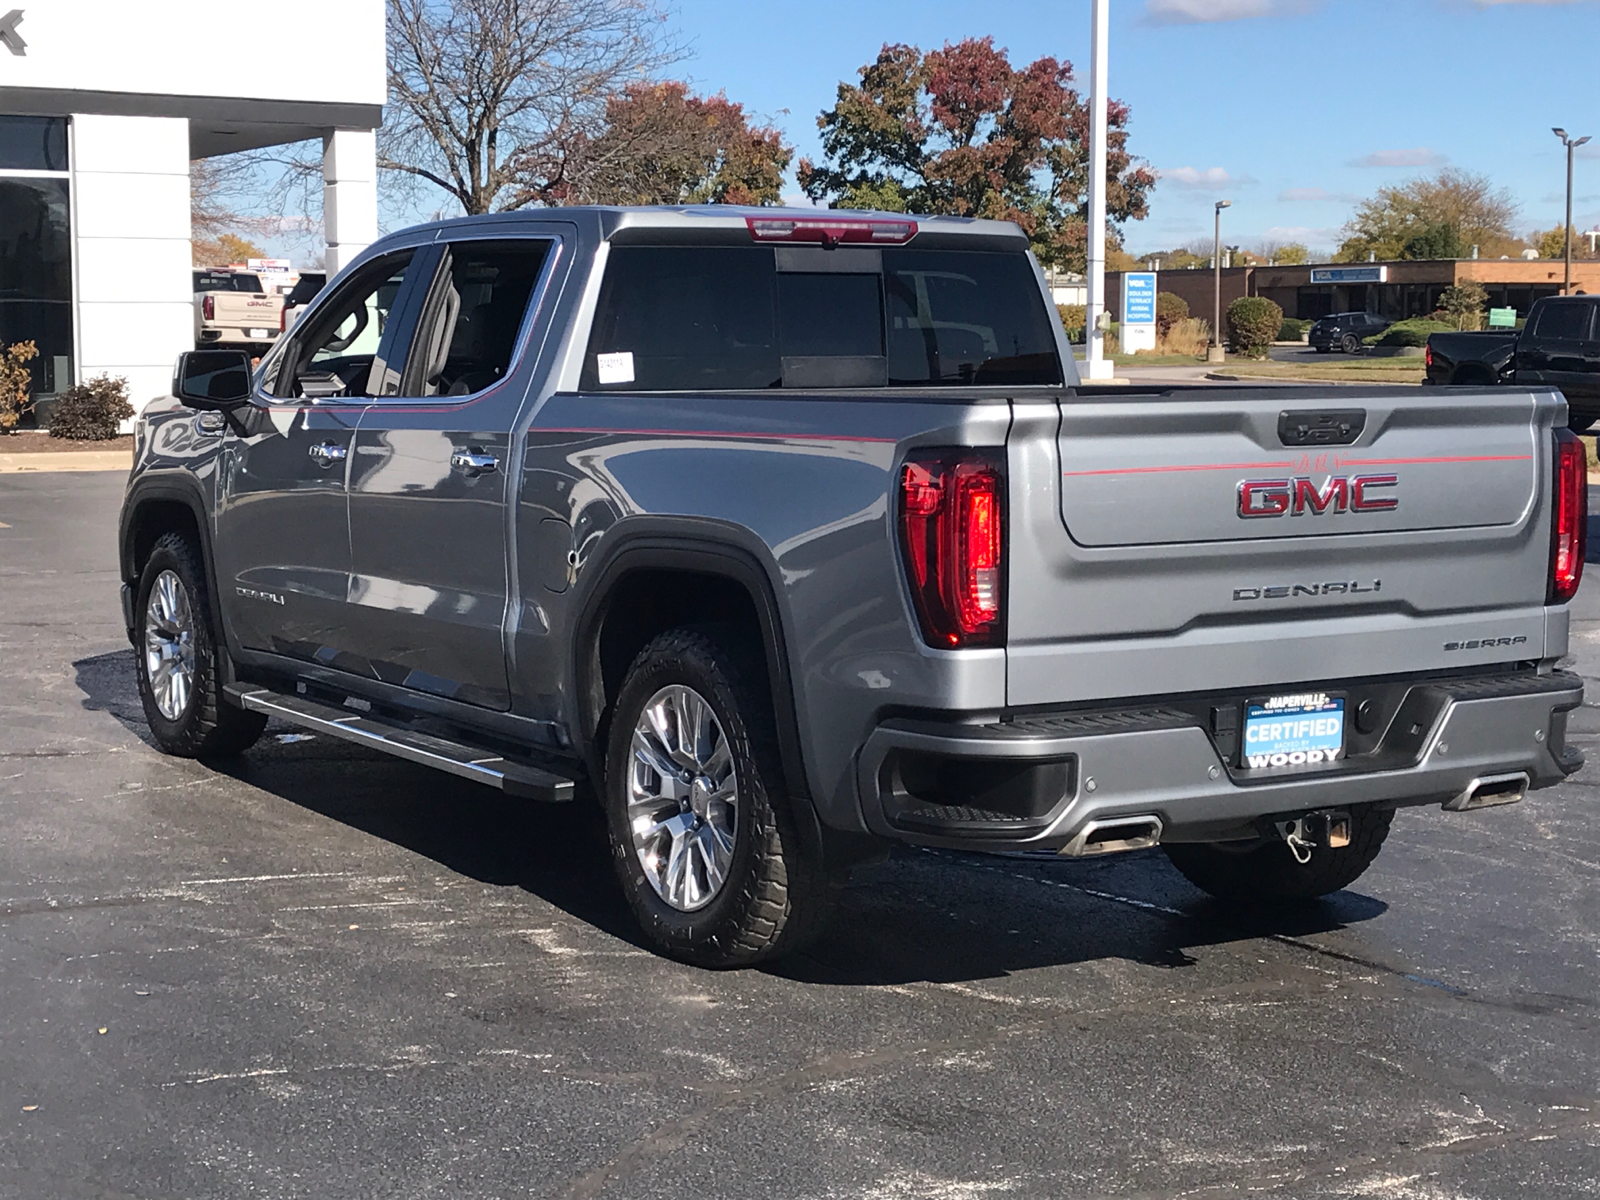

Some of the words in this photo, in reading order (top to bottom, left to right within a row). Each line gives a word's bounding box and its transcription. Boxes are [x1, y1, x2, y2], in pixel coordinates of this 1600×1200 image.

[1129, 279, 1145, 288] VCA
[1236, 472, 1398, 520] GMC
[236, 587, 284, 605] DENALI
[1232, 578, 1382, 601] DENALI
[1443, 635, 1527, 651] SIERRA
[1270, 694, 1325, 708] NAPERVILLE
[1246, 718, 1340, 743] CERTIFIED
[1274, 741, 1300, 749] BACKED
[1301, 739, 1310, 747] BY
[1248, 748, 1341, 769] WOODY
